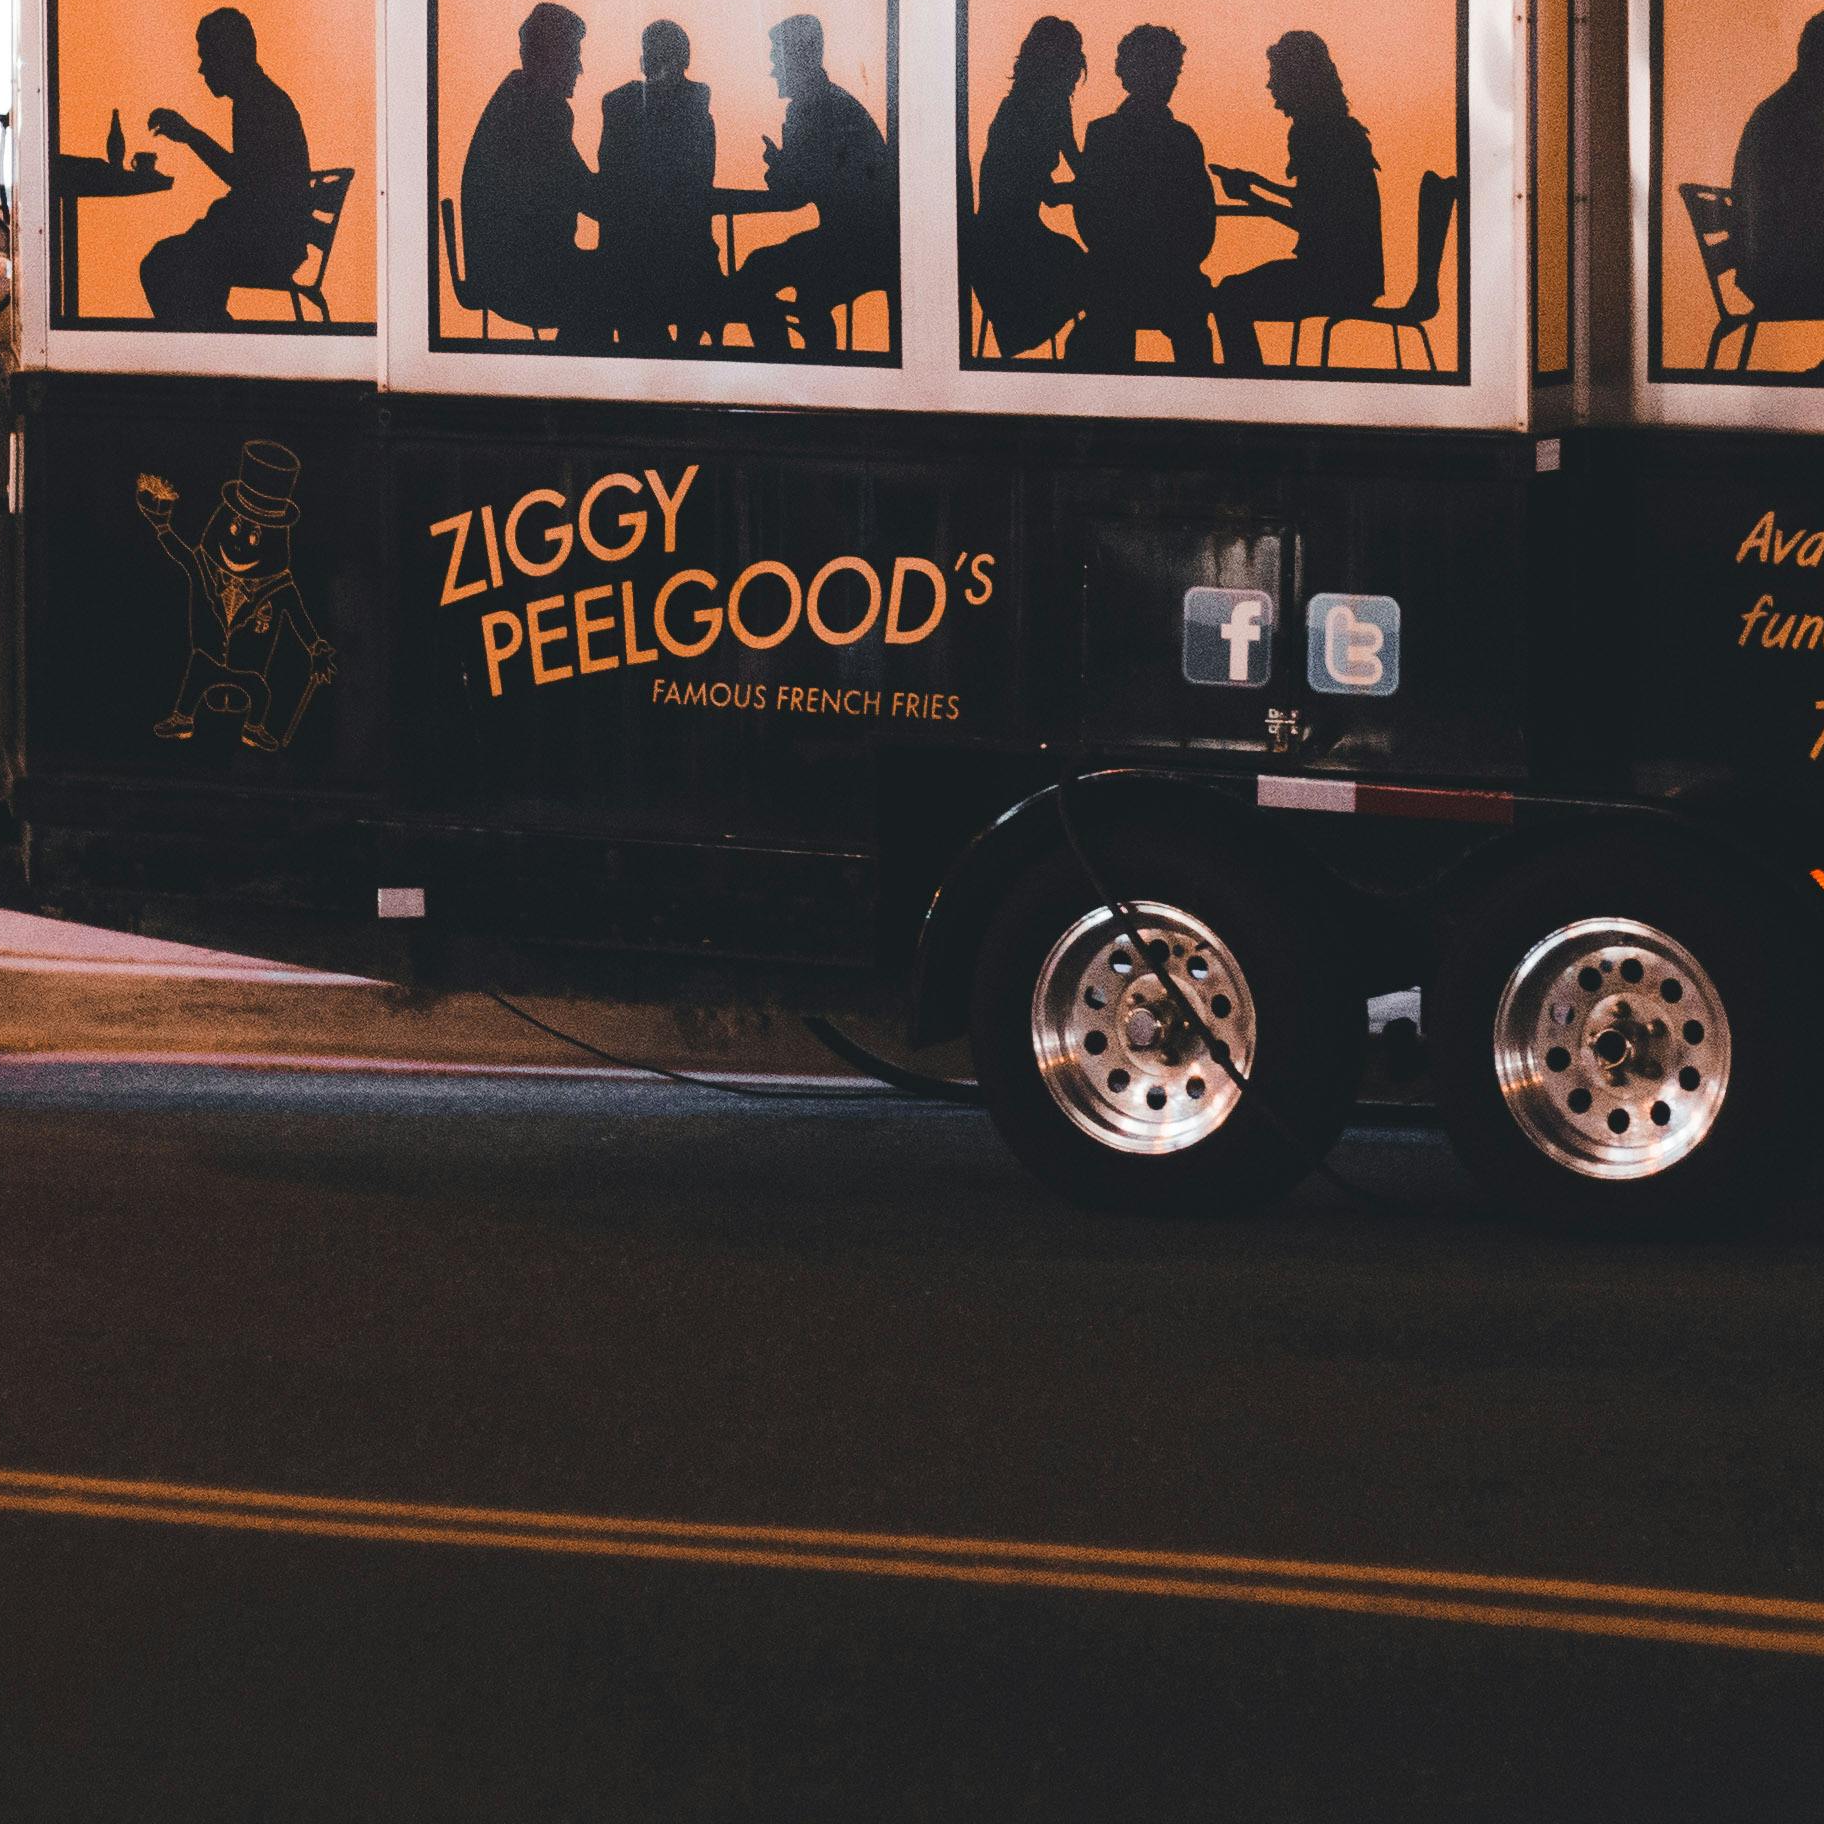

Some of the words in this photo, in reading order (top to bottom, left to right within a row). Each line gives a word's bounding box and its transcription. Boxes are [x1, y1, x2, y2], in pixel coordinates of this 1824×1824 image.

[429, 464, 700, 607] ZIGGY
[480, 551, 998, 697] PEELGOOD'S
[652, 678, 767, 710] FAMOUS
[776, 685, 881, 716] FRENCH
[891, 690, 960, 721] FRIES
